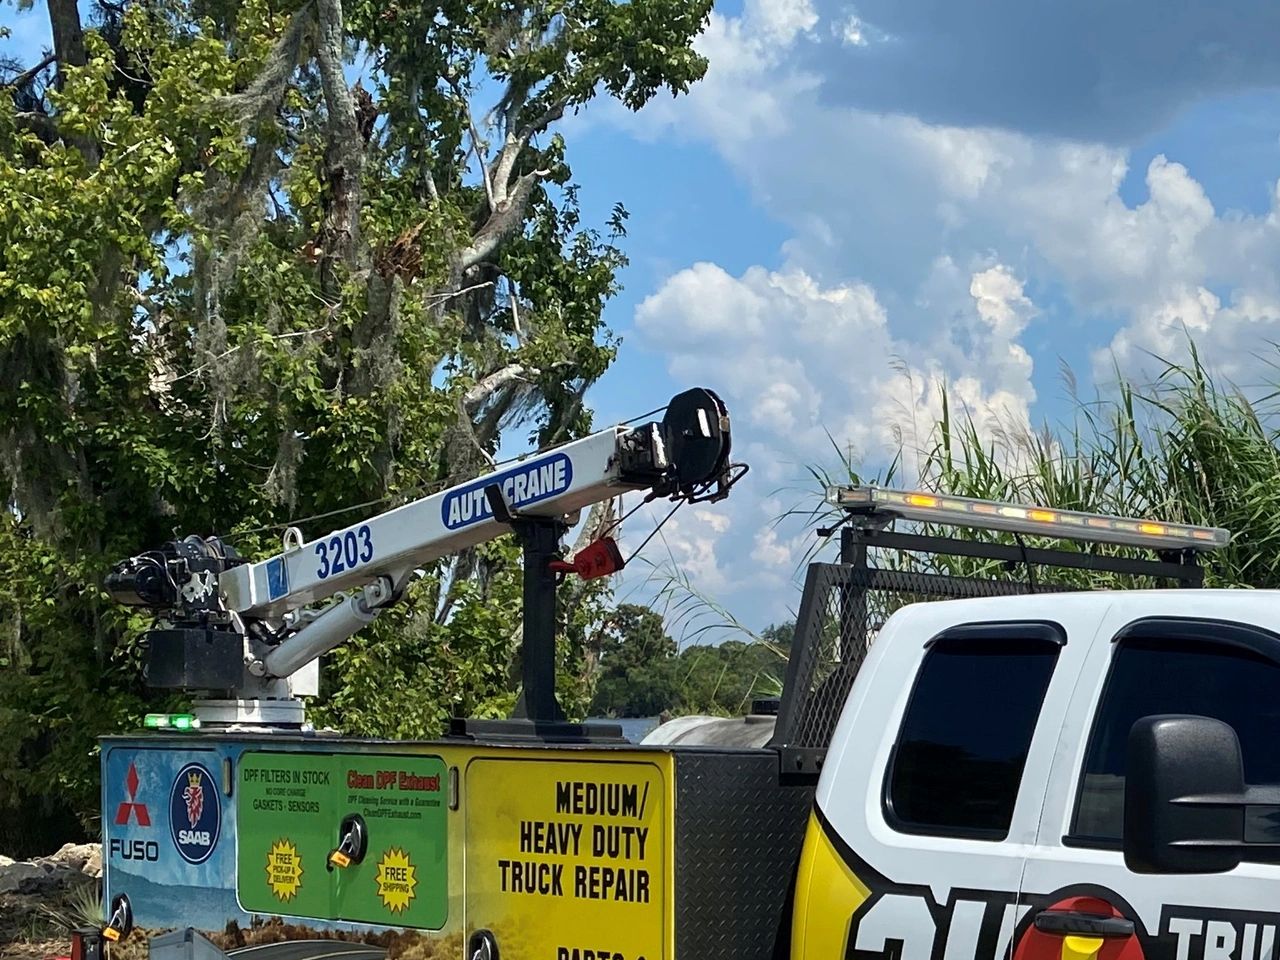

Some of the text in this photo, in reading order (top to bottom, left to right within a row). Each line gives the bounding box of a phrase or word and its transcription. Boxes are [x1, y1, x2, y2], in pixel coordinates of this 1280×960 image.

[503, 459, 566, 505] CRANE
[315, 525, 373, 579] 3203
[244, 769, 330, 784] DPF FILTERS IN STOCK
[347, 770, 440, 792] Clean DPF Exhaust
[253, 799, 283, 811] GASKETS
[288, 800, 320, 812] SENSORS
[556, 781, 650, 820] MEDIUM/
[178, 830, 210, 846] SAAB
[520, 821, 649, 860] HEAVY DUTY
[110, 839, 158, 862] FUSO
[276, 853, 292, 864] FREE
[385, 867, 407, 881] FREE
[498, 860, 650, 903] TRUCK REPAIR
[383, 882, 409, 894] SHIPPING
